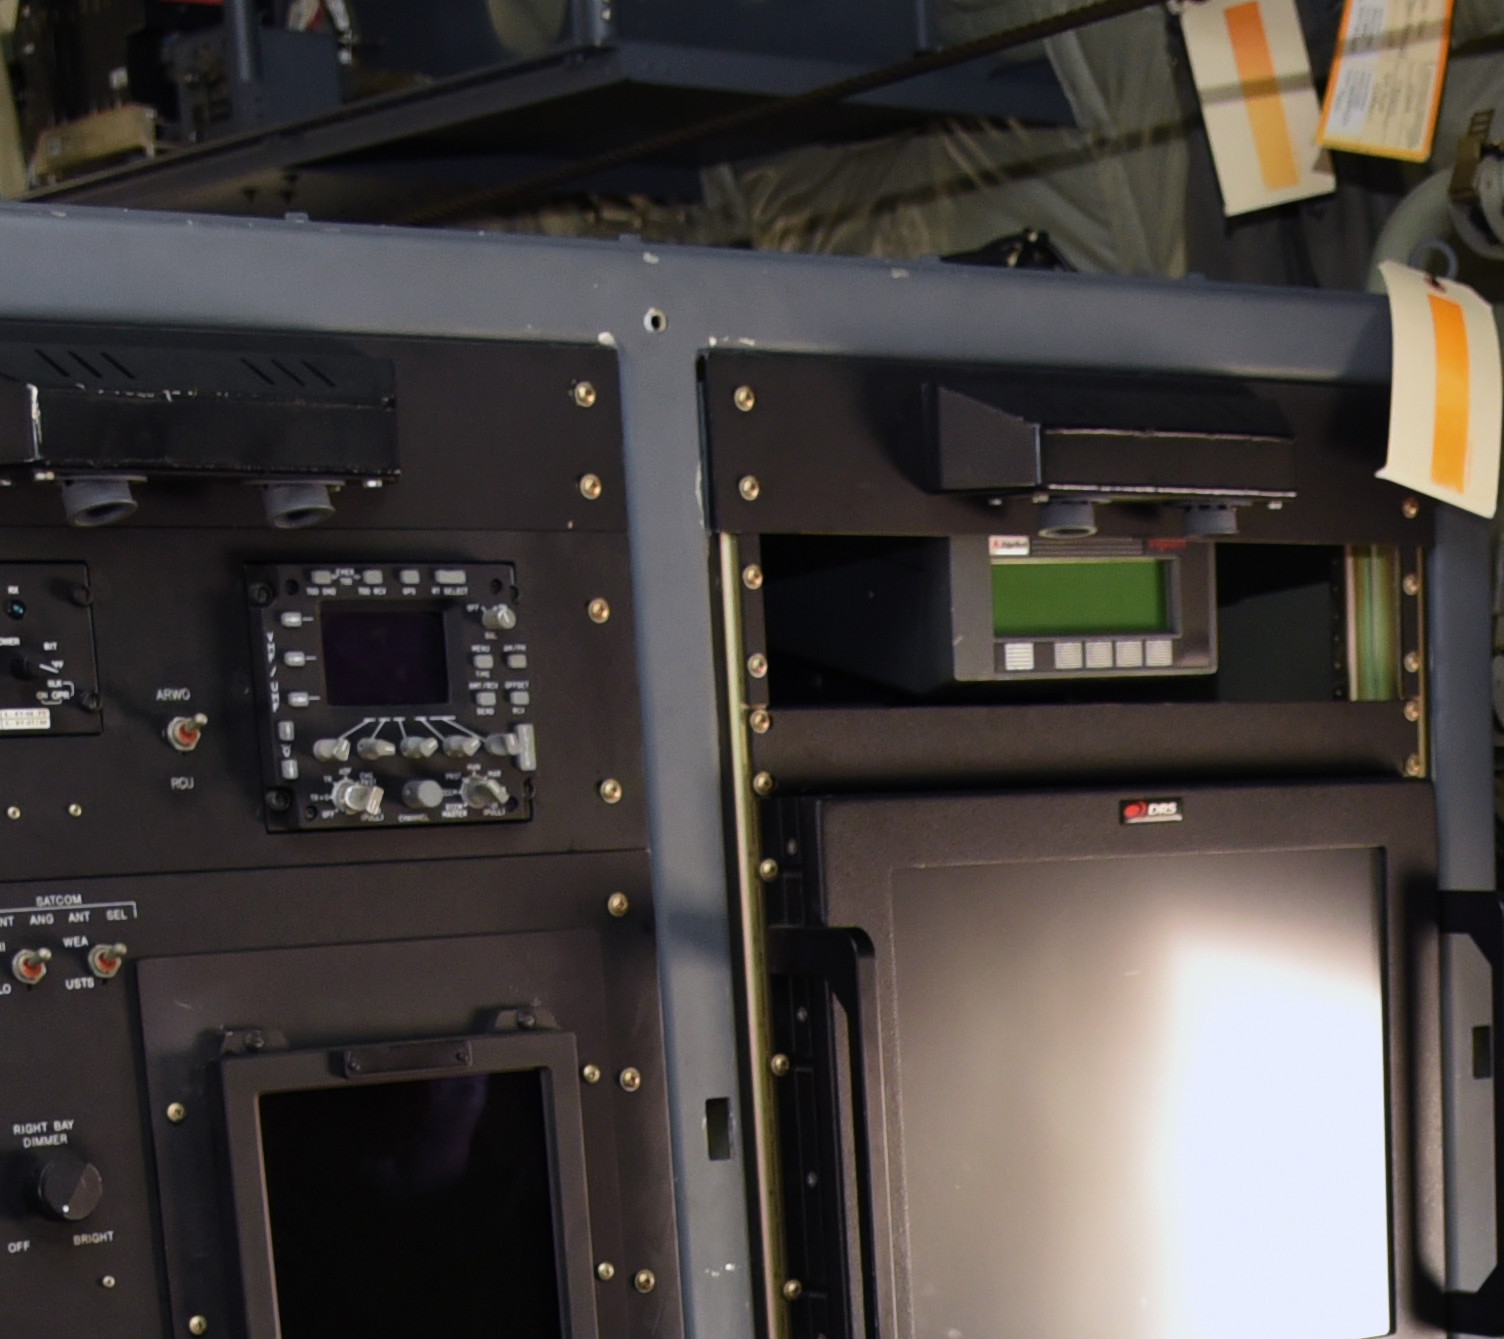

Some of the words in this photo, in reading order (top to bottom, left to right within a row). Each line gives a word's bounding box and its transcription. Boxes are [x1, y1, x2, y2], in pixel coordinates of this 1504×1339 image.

[36, 895, 82, 907] SATCOM
[68, 912, 91, 923] ANT
[106, 910, 128, 921] SEL
[13, 1121, 49, 1136] RIGHT
[53, 1120, 75, 1132] BAY
[23, 1133, 68, 1149] DIMMER
[7, 1240, 31, 1253] OFF
[73, 1230, 115, 1246] BRIGHT
